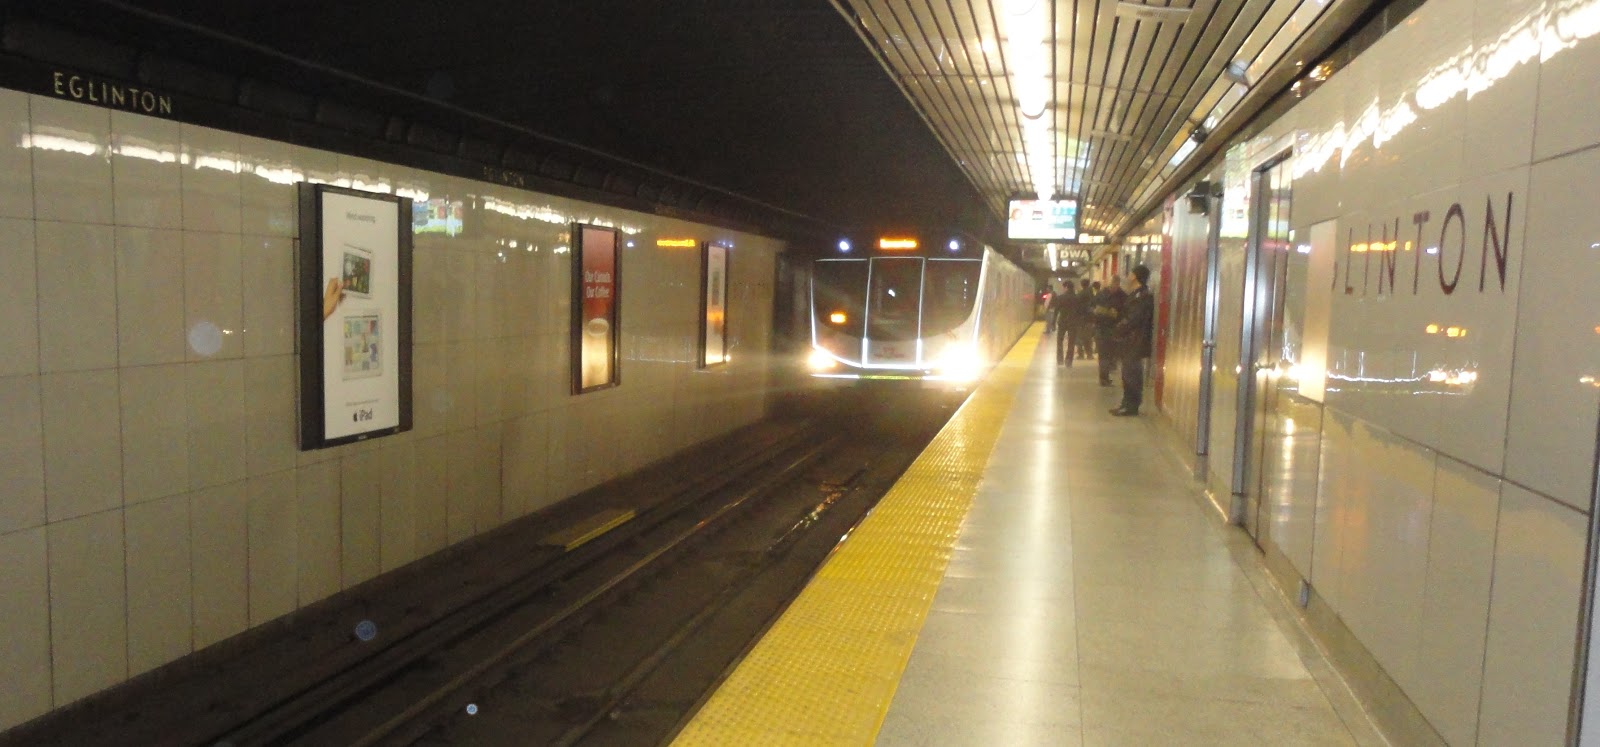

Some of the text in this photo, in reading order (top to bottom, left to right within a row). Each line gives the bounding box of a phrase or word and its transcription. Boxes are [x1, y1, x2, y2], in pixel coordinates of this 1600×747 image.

[53, 71, 172, 114] EGLINTON
[1331, 190, 1513, 295] LINTON
[359, 407, 373, 422] iPad
